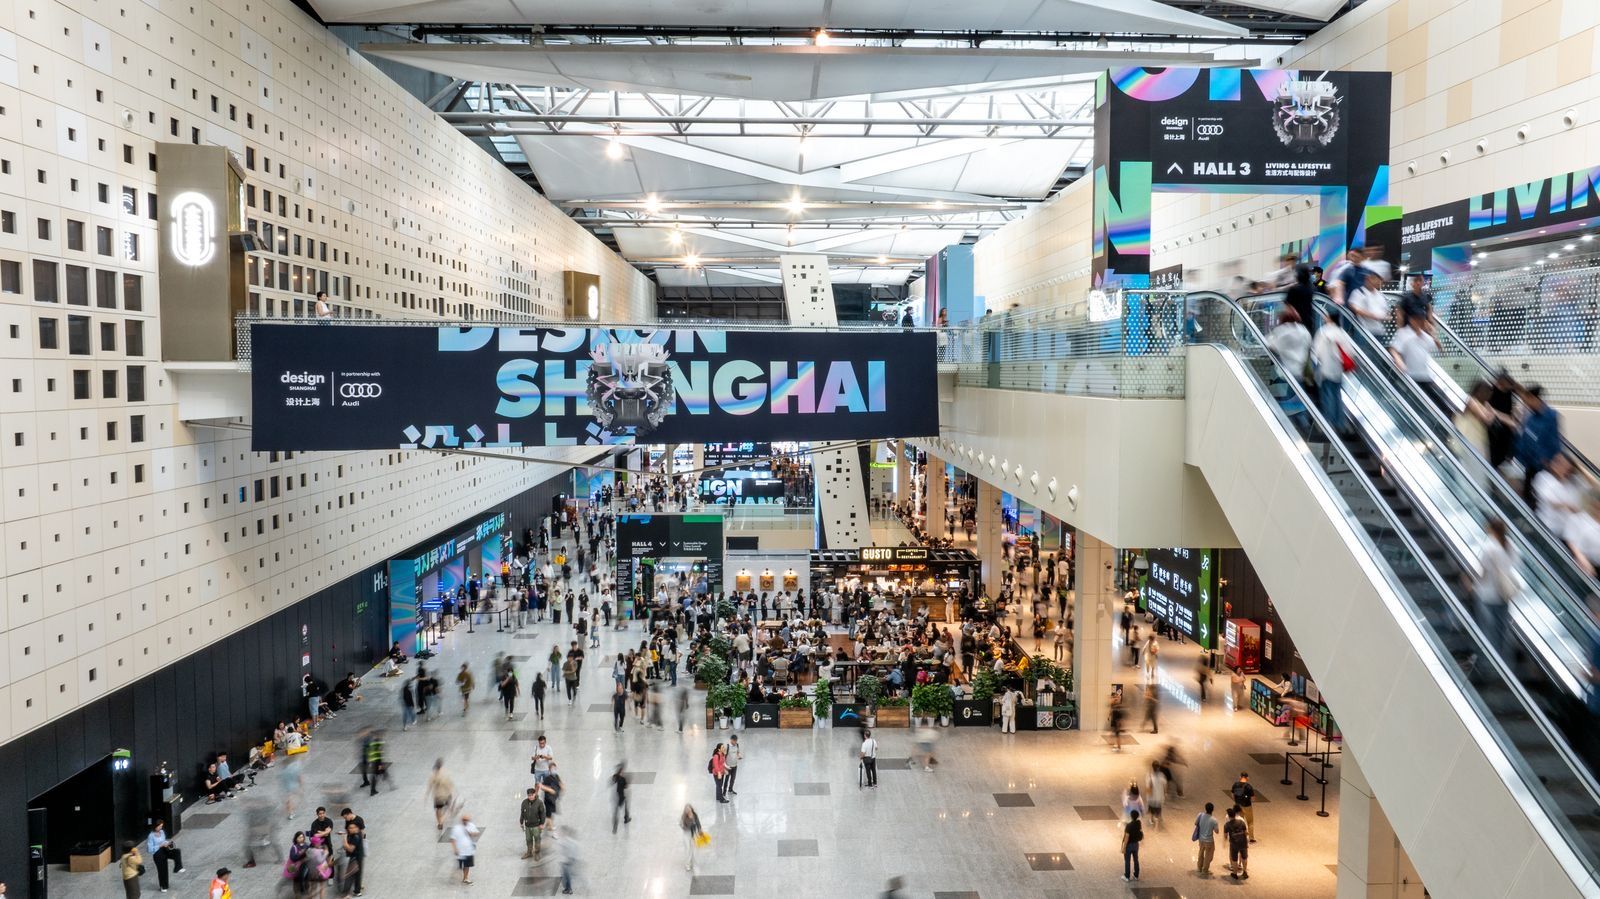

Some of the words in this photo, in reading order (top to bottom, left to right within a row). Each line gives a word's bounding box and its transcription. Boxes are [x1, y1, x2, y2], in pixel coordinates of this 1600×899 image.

[1161, 116, 1188, 126] design
[1193, 162, 1236, 175] HALL
[1240, 162, 1251, 176] 3
[1415, 223, 1421, 232] &
[1421, 216, 1454, 231] LIFESTYLE
[280, 371, 325, 385] design
[495, 358, 886, 418] SHNGHAI
[286, 397, 320, 407] 设计上海
[862, 549, 892, 559] GUSTO
